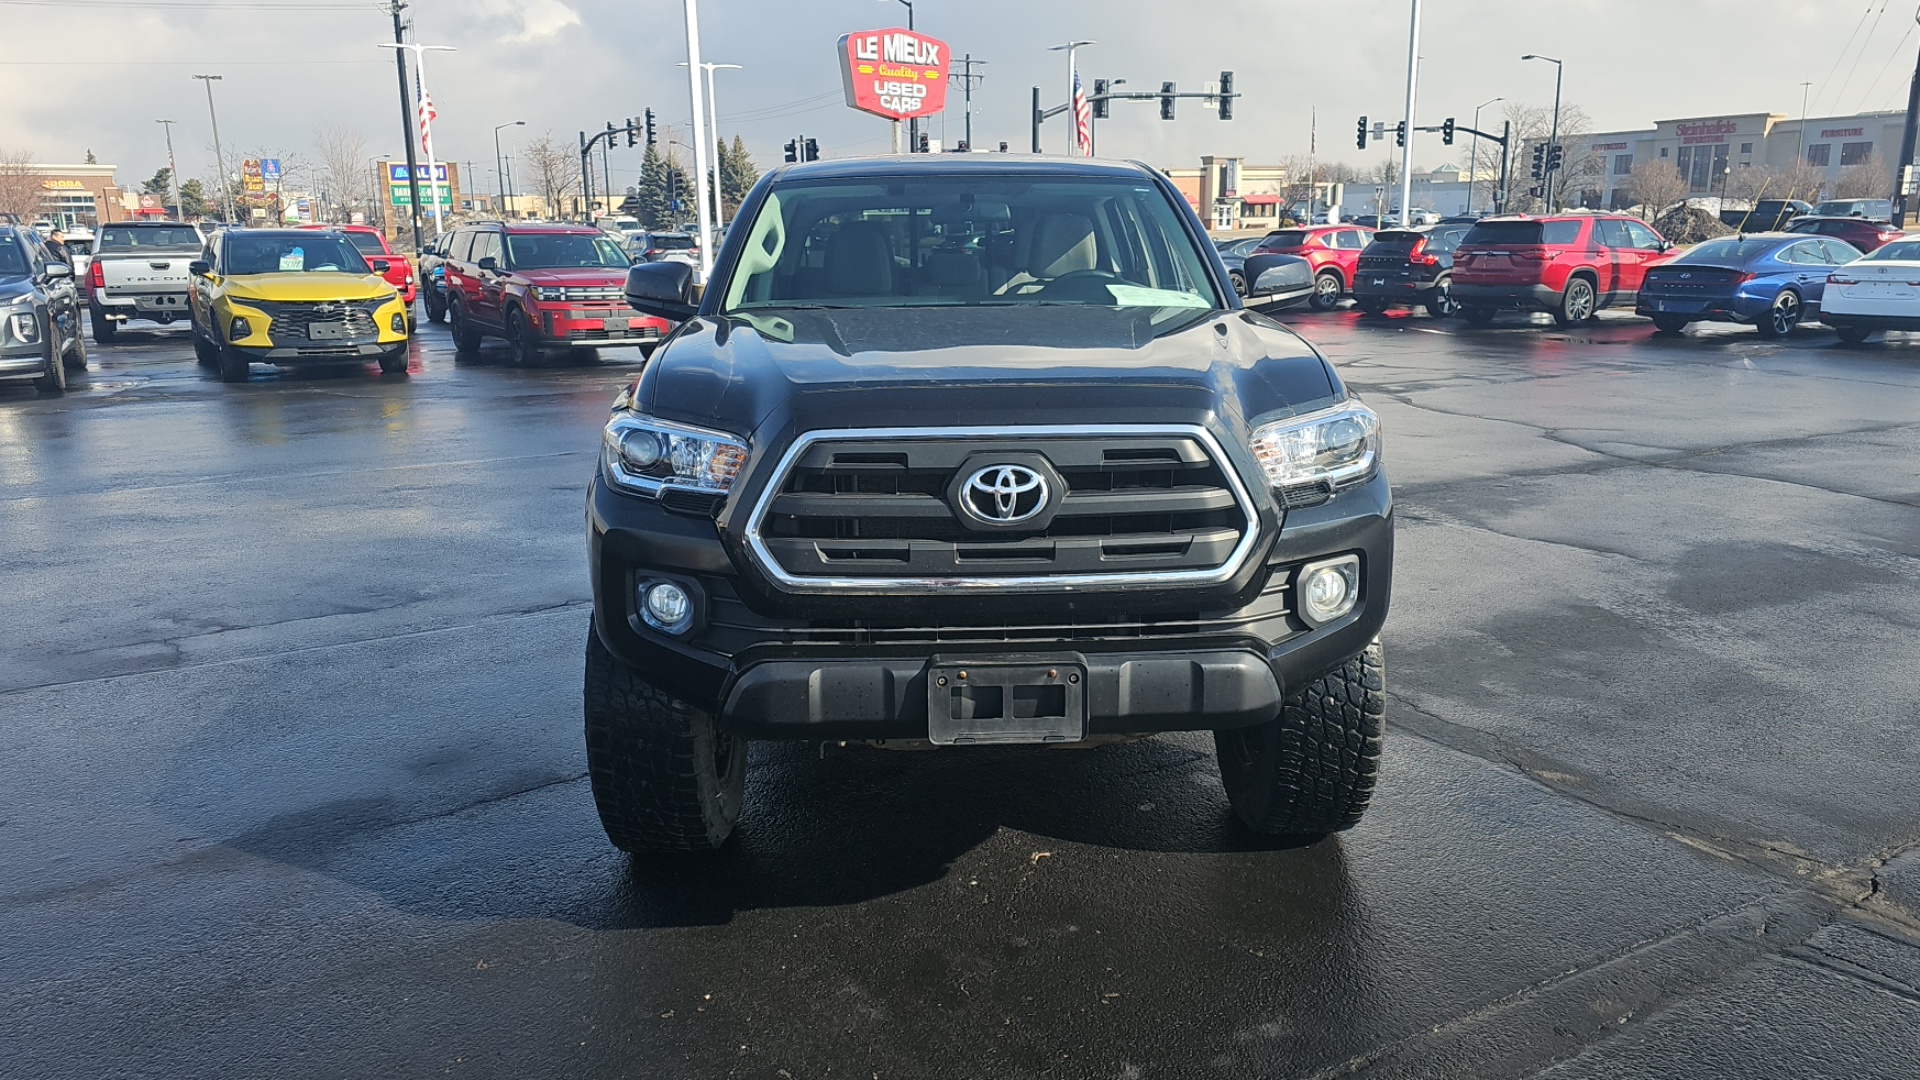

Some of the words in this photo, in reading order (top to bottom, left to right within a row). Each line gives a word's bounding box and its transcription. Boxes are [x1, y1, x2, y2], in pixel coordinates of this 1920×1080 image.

[856, 36, 879, 61] LE
[883, 33, 940, 66] MIEUX
[879, 64, 920, 81] Quality
[874, 80, 927, 98] USED
[880, 96, 922, 114] CARS
[1820, 127, 1865, 139] FURNITURE
